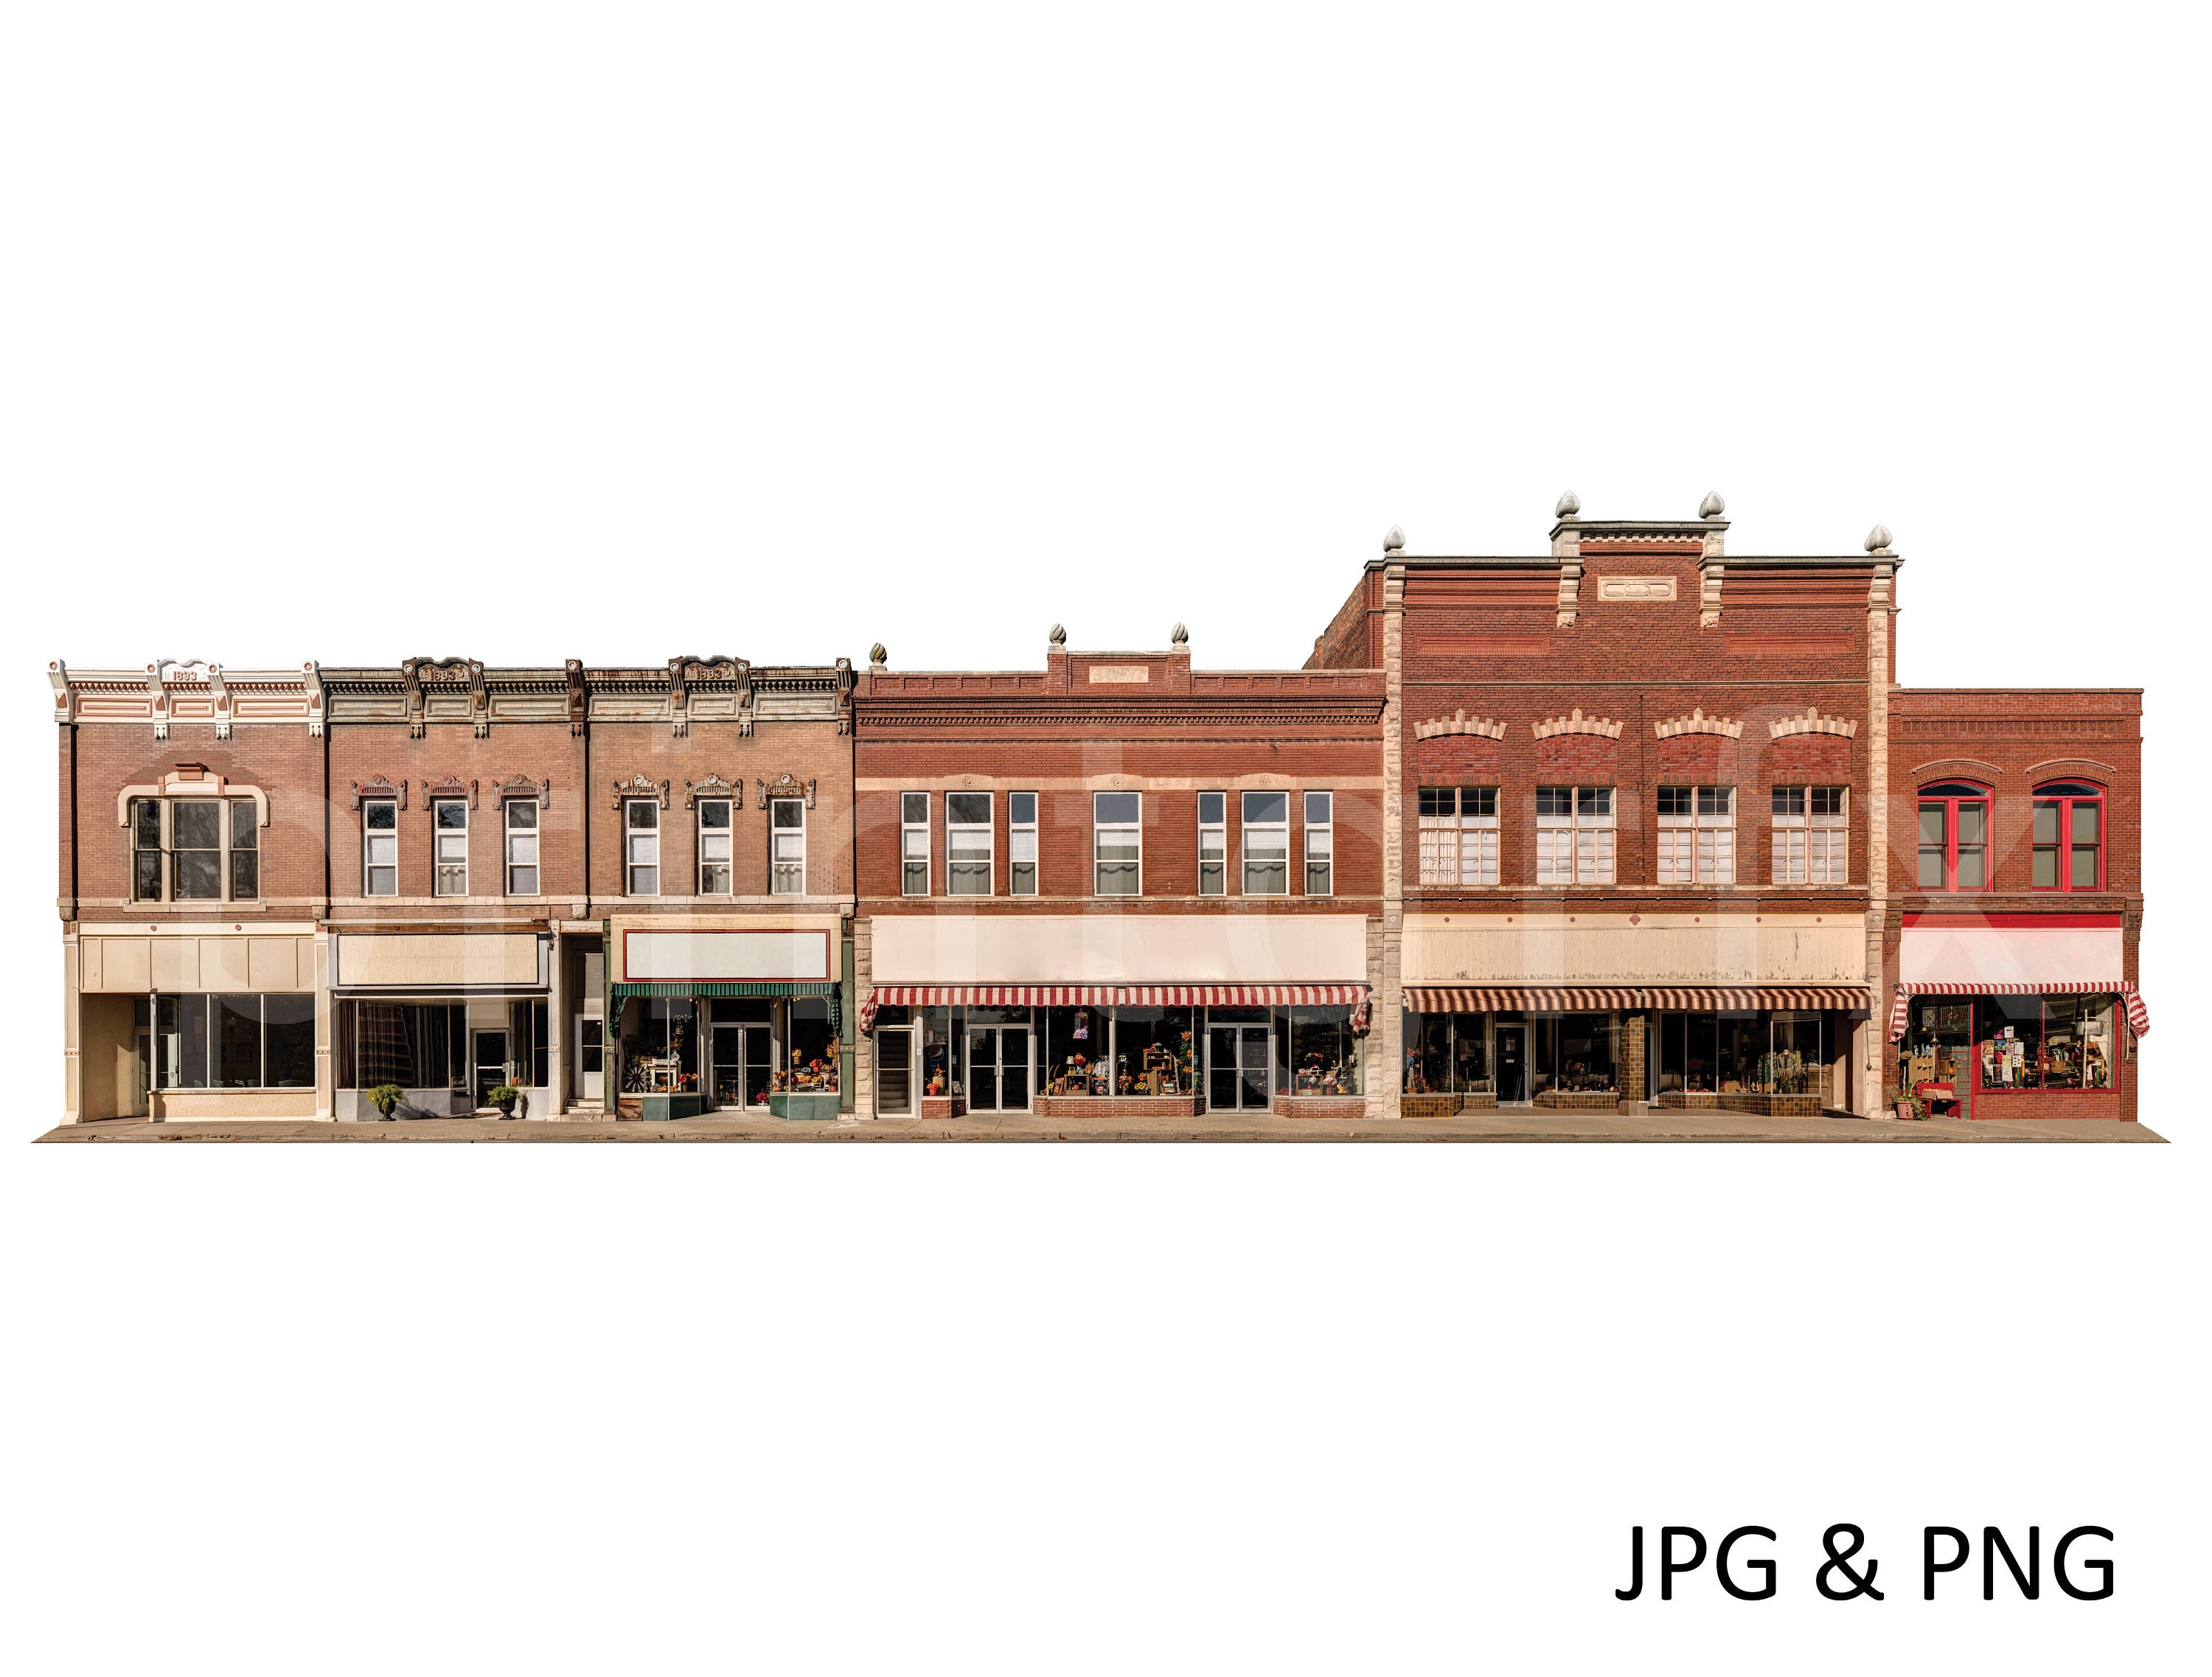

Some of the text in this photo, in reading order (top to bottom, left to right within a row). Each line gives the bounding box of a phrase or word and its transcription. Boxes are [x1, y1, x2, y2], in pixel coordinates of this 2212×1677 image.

[173, 670, 198, 681] 1893
[430, 668, 456, 681] 1893
[696, 667, 723, 680] 1893
